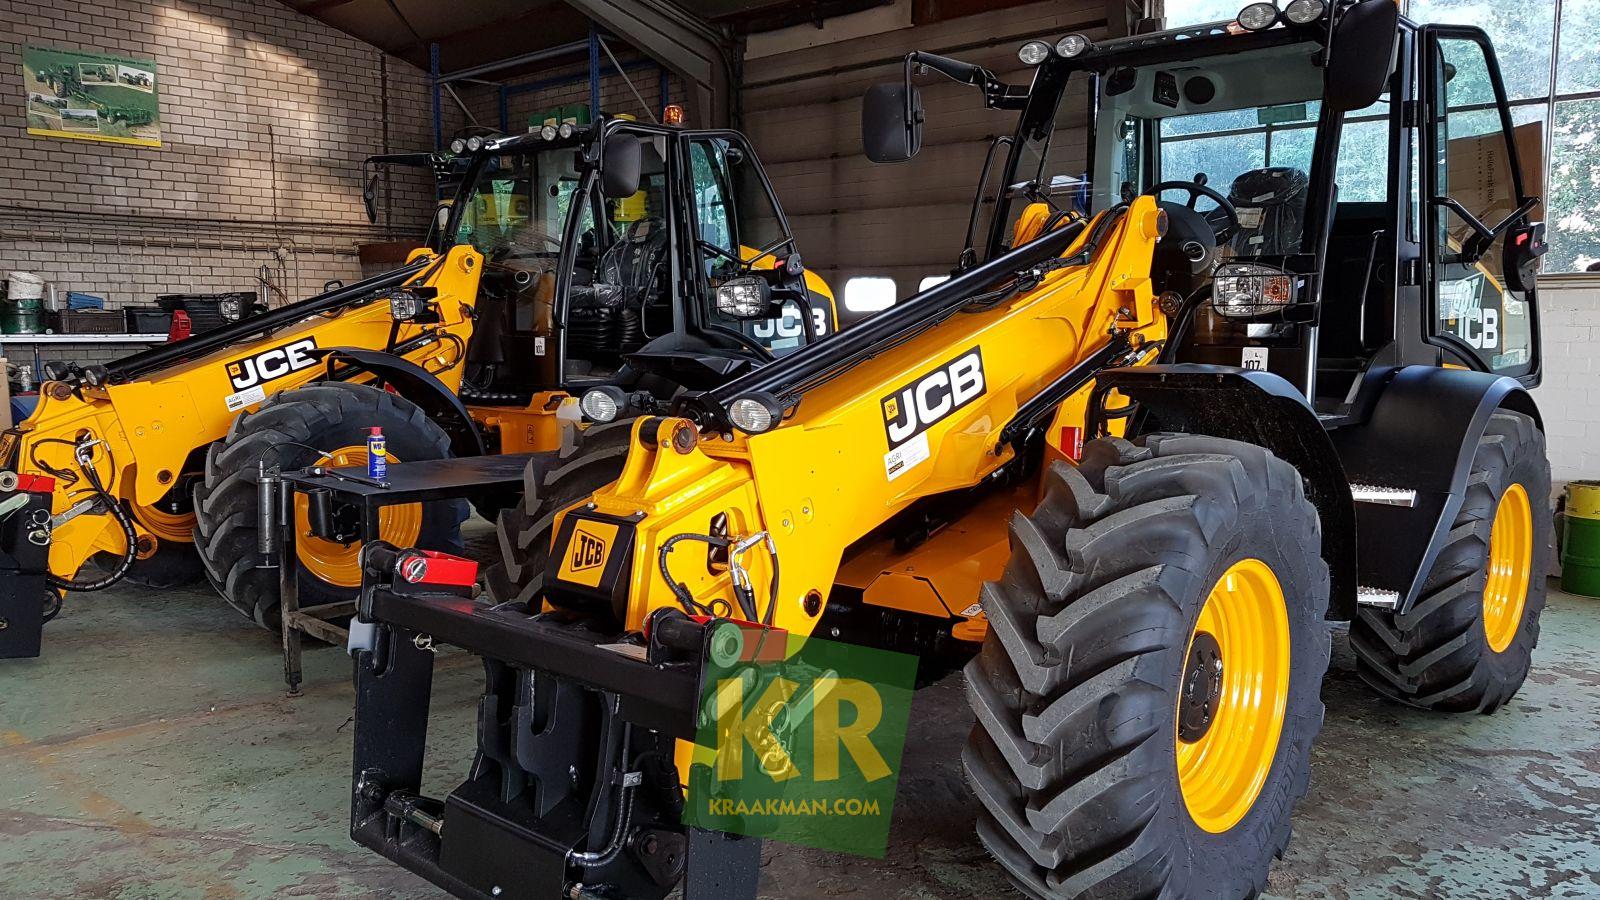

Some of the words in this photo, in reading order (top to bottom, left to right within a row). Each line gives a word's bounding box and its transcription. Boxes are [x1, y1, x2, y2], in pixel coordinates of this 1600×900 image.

[232, 340, 317, 389] JCB
[888, 353, 984, 442] JCB
[887, 450, 902, 465] AGRI
[573, 535, 603, 567] JCB
